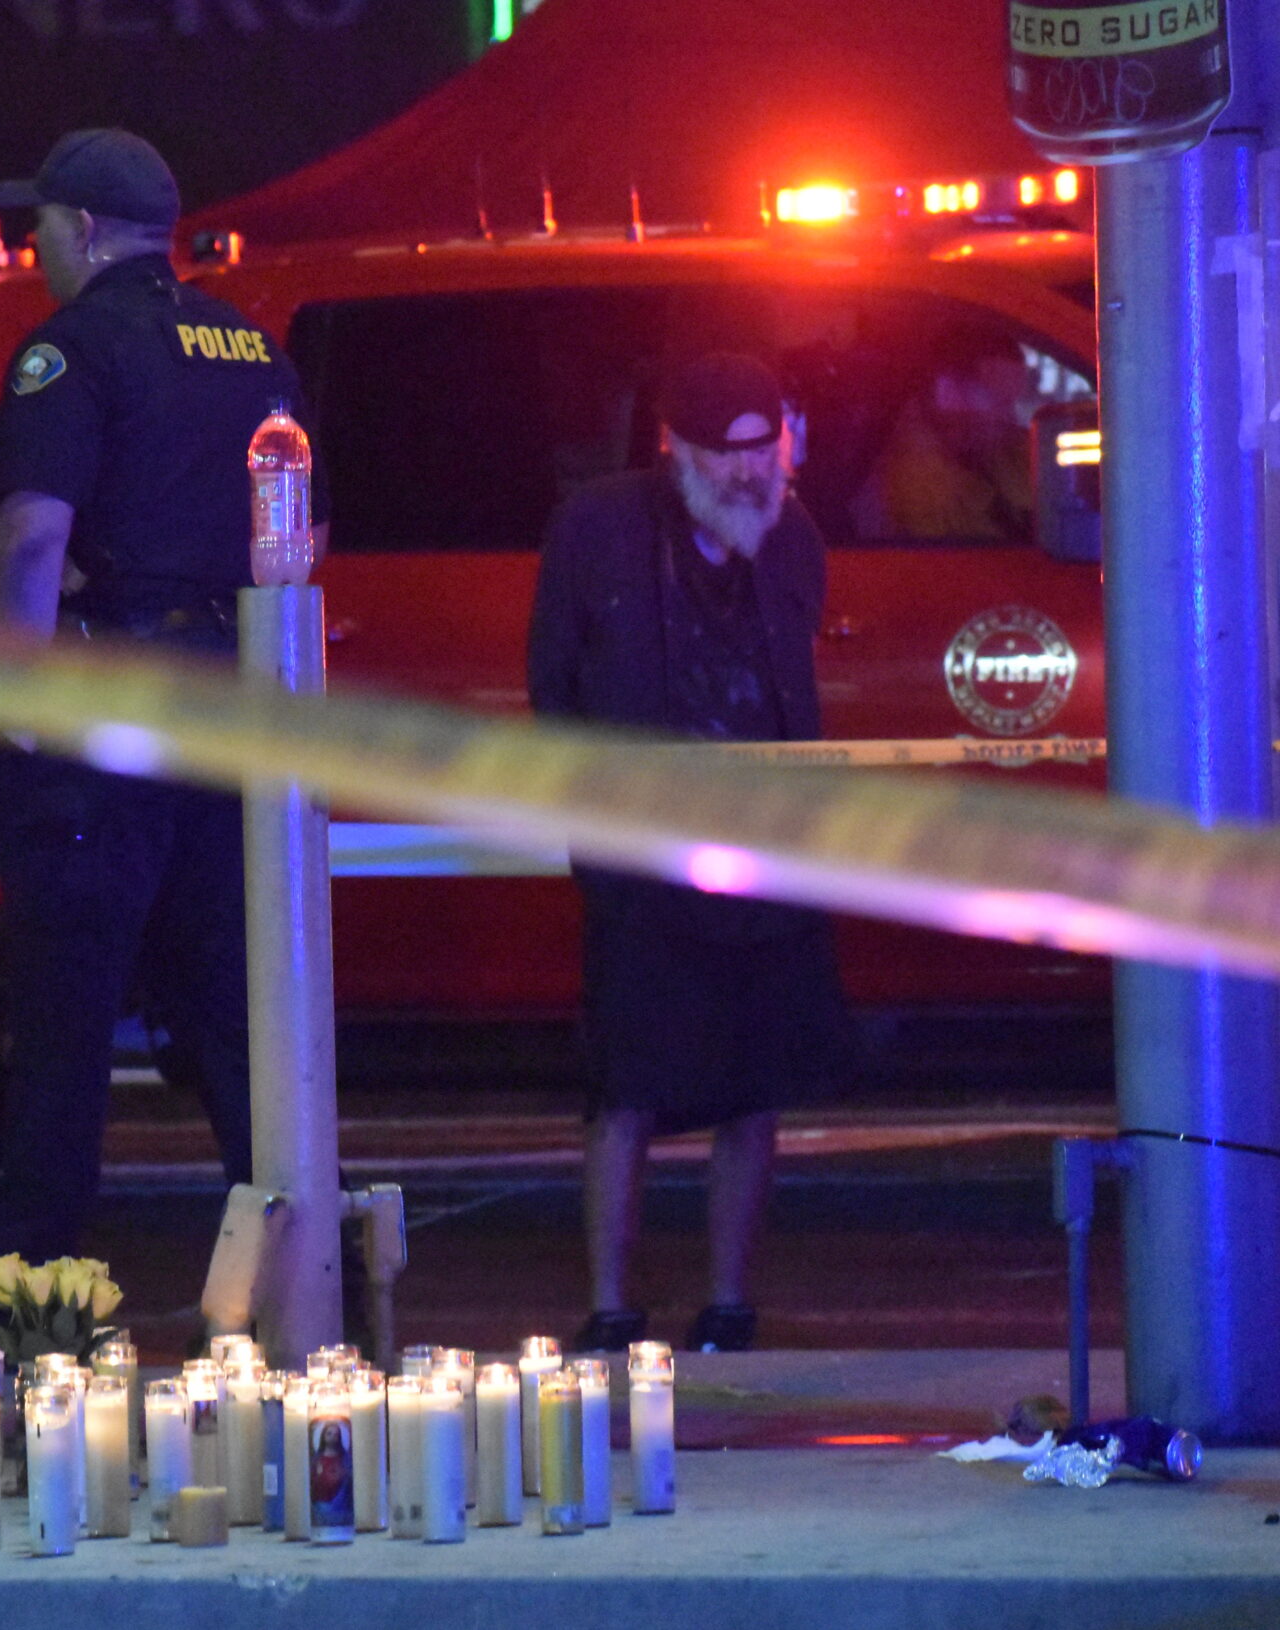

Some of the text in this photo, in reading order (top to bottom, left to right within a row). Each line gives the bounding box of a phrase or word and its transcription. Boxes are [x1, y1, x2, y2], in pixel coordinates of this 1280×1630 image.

[1013, 1, 1215, 46] ZERO SUGAR
[176, 323, 271, 363] POLICE
